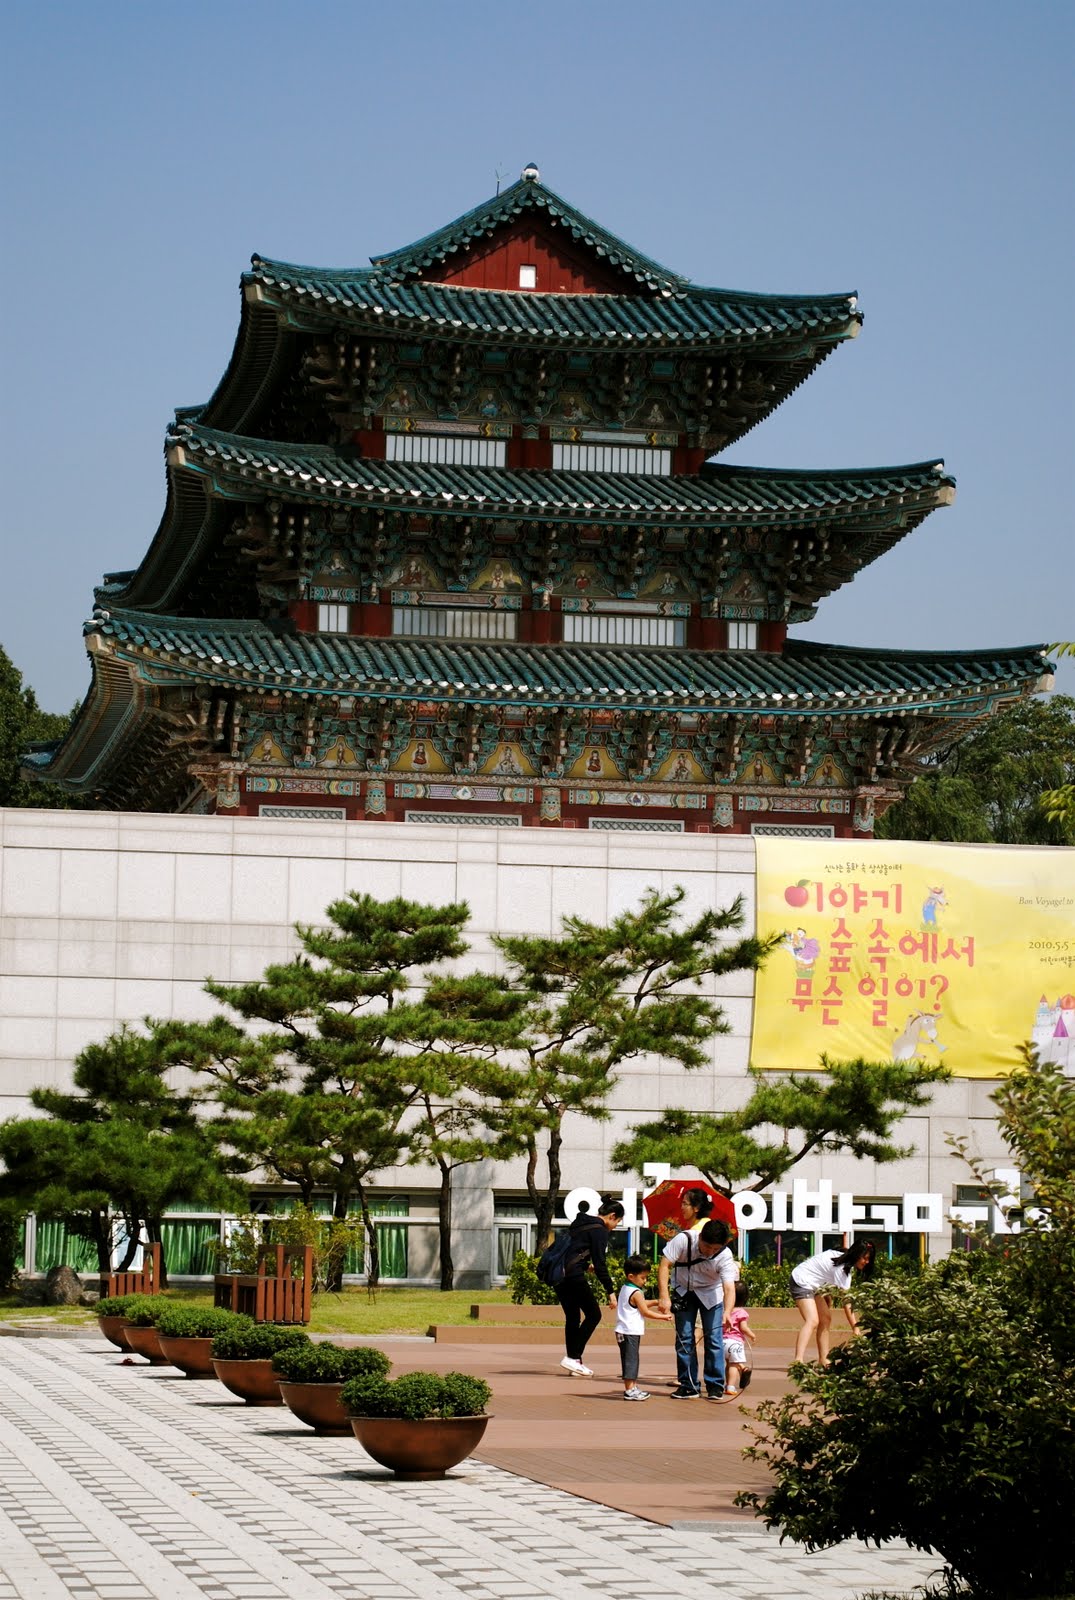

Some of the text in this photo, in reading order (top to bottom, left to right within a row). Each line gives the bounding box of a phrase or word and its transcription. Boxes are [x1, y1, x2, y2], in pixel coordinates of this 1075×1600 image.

[824, 863, 843, 874] 신나는
[846, 862, 859, 874] 동화
[869, 863, 903, 876] 상상놀이터
[784, 879, 902, 914] 이야기
[1018, 896, 1033, 905] Bon
[1035, 896, 1066, 908] Voyage!
[829, 917, 975, 973] 숲 속에서
[1029, 941, 1069, 951] 2010.5.5
[787, 972, 949, 1027] 무슨 일이?
